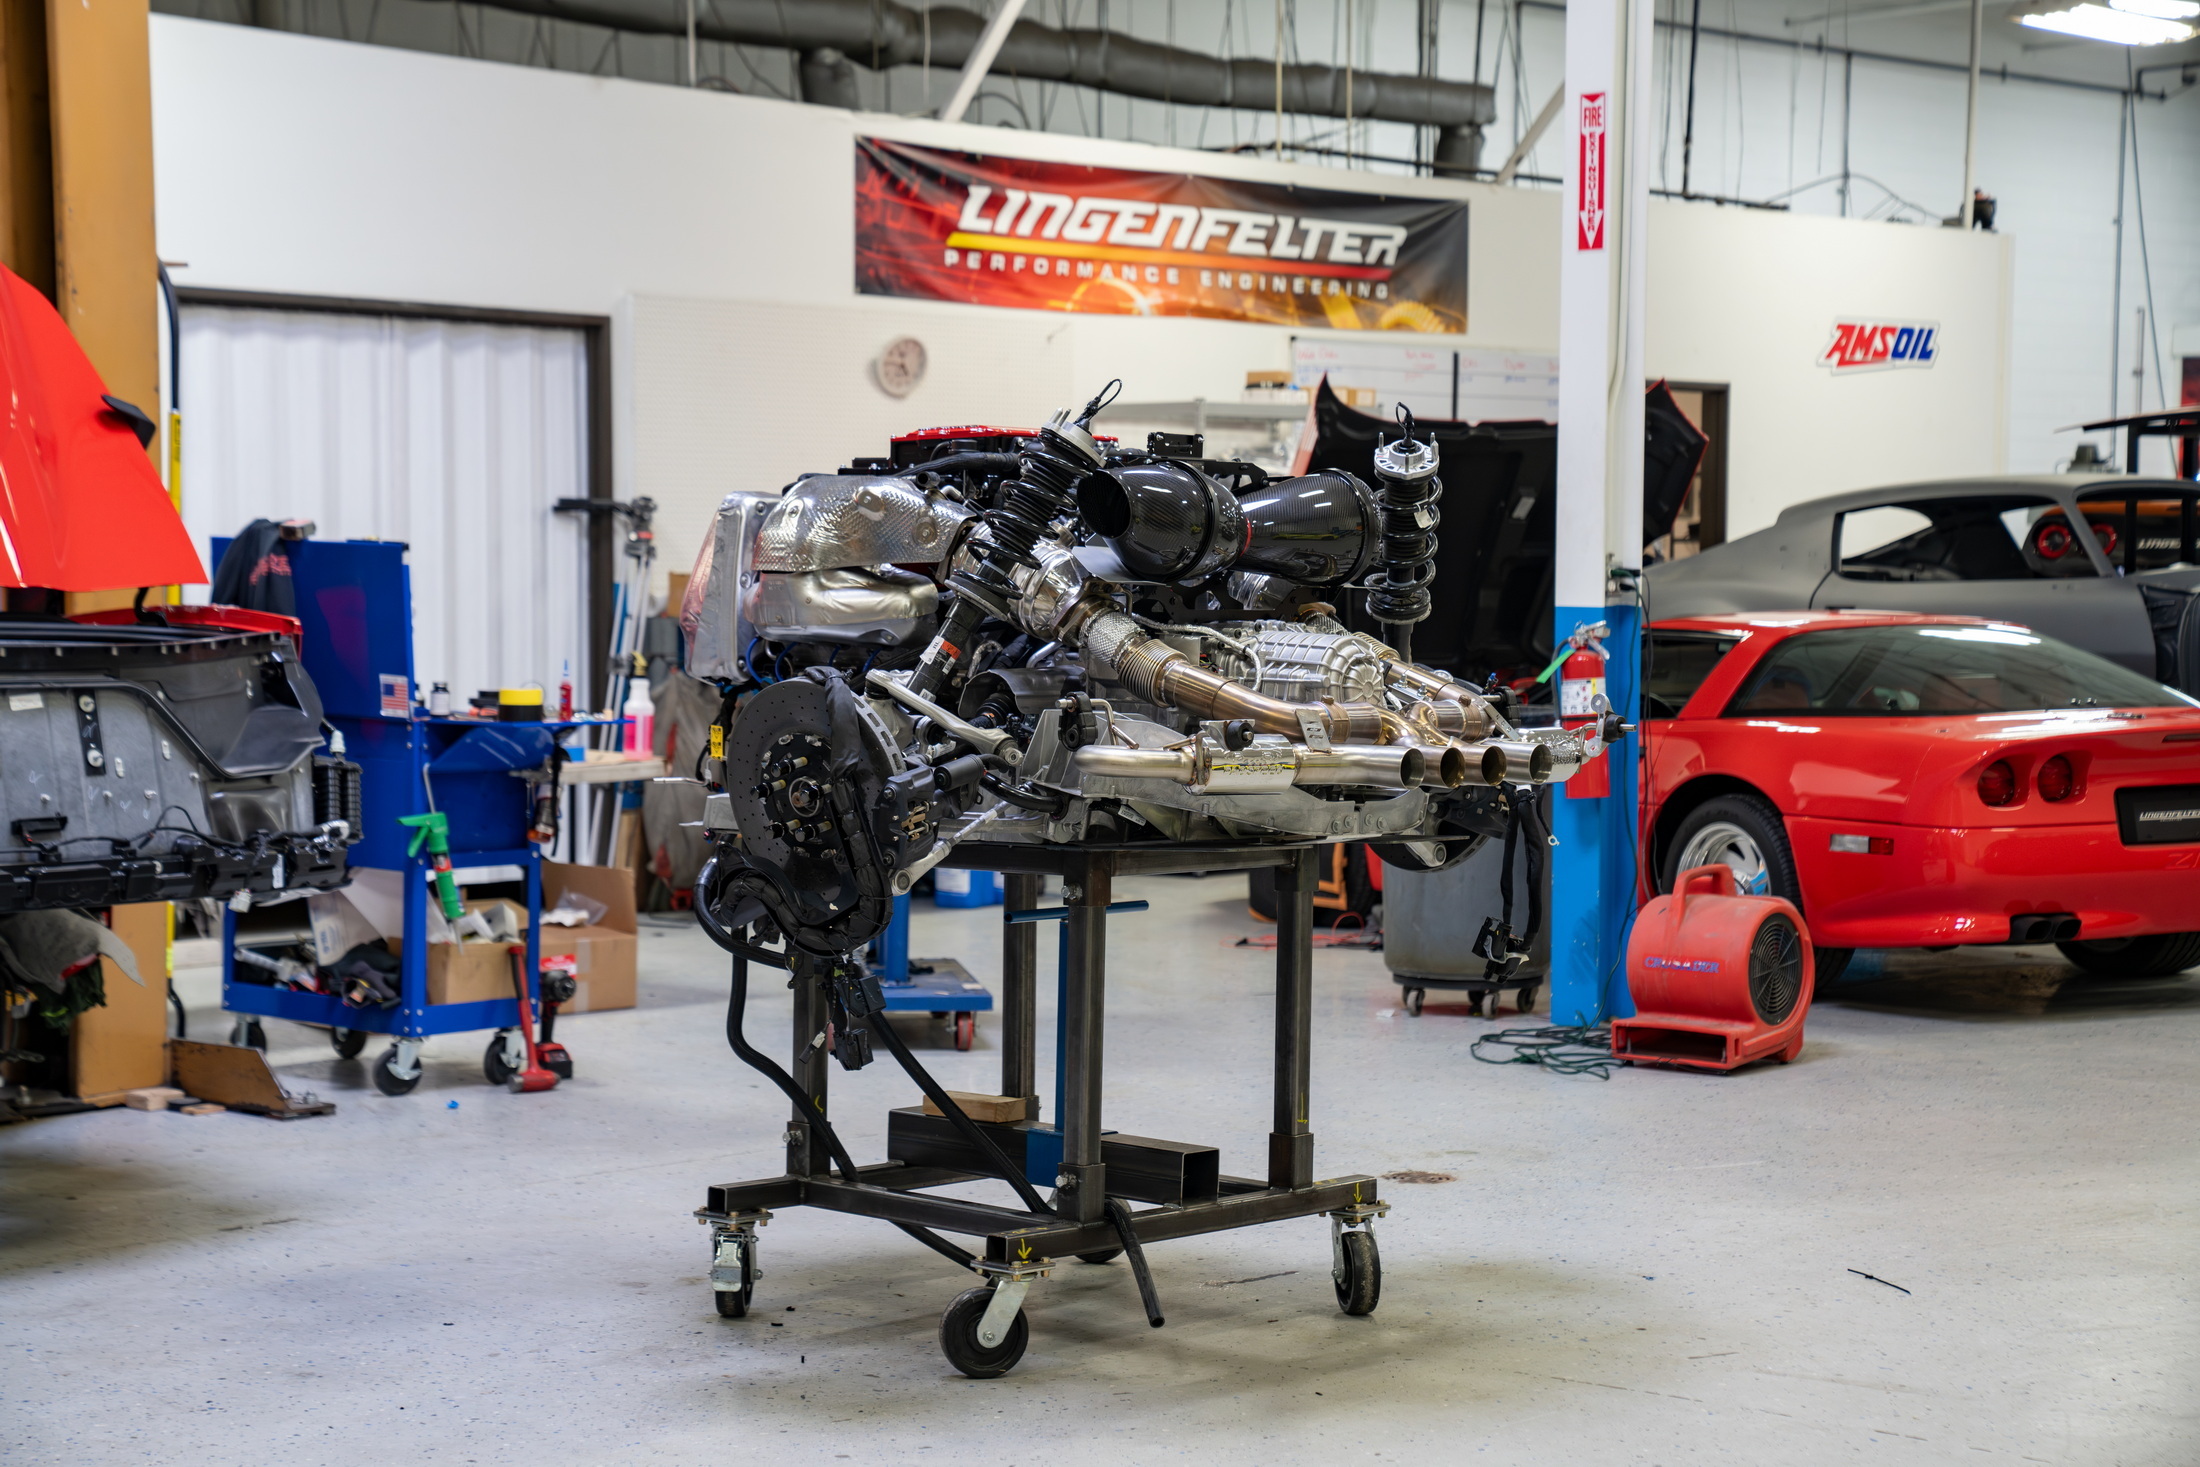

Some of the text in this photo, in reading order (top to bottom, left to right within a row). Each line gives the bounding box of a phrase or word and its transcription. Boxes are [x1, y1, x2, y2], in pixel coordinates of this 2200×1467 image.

[1584, 106, 1602, 127] FIRE
[1588, 132, 1596, 231] EXTINGUISHER
[957, 184, 1407, 266] LINGENFELTER
[943, 248, 1389, 300] PERFORMANCE ENGINEERING
[1825, 323, 1934, 368] AMSOIL
[1644, 956, 1719, 973] CRUSADER
